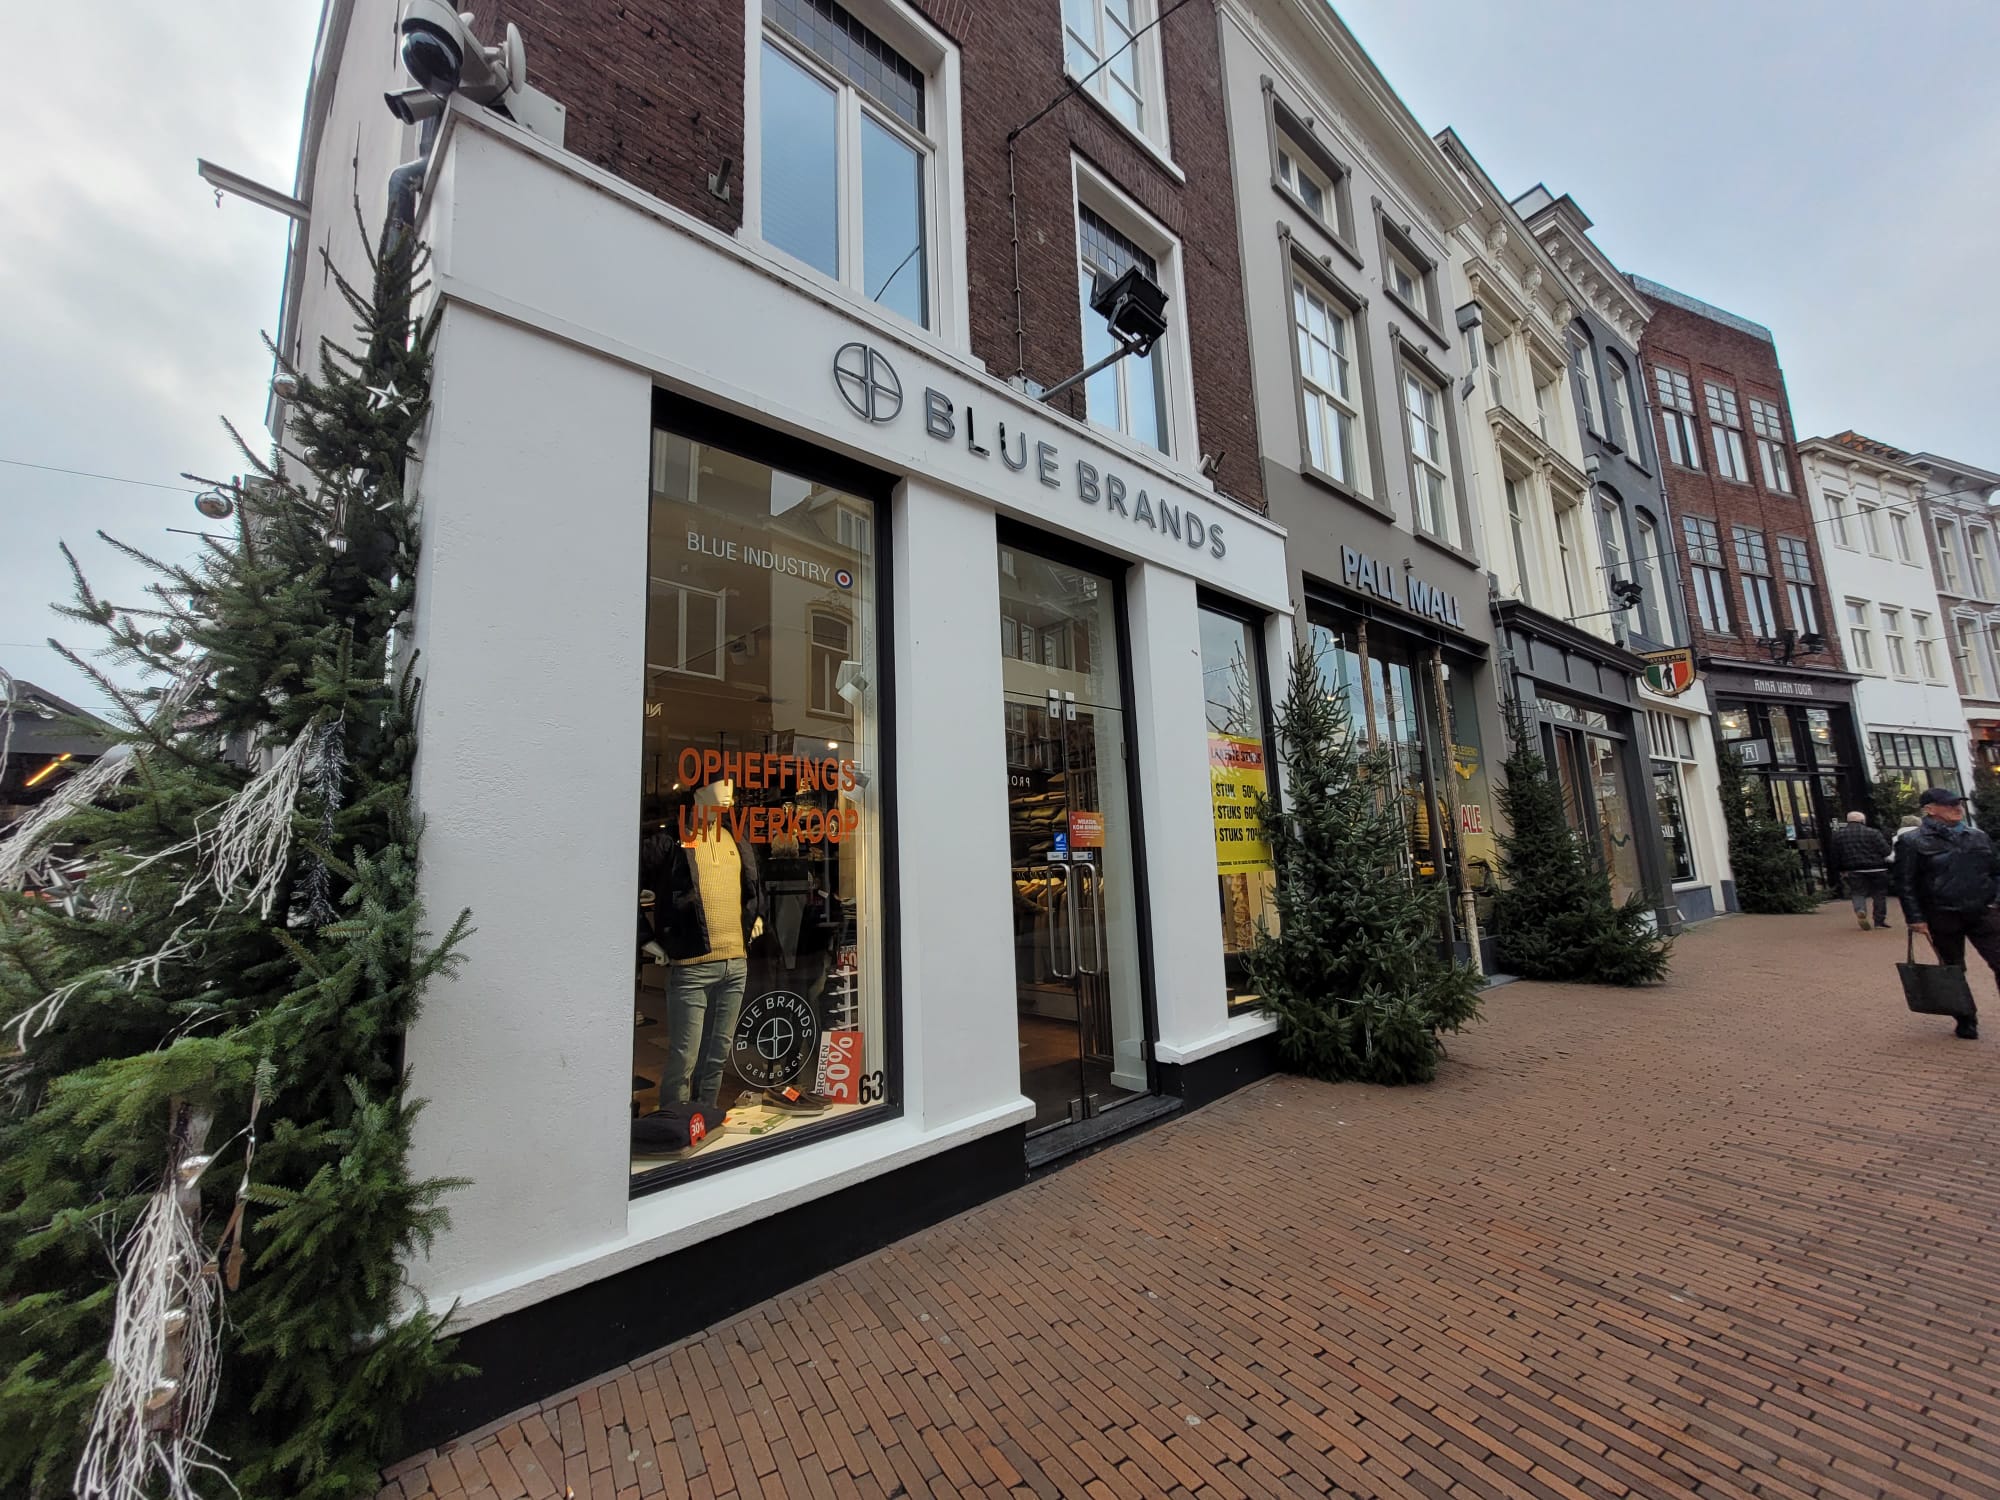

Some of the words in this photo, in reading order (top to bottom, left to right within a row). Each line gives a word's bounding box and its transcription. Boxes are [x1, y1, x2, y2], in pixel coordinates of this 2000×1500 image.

[925, 386, 1061, 487] BLUE
[1077, 459, 1227, 559] BRANDS
[687, 531, 737, 561] BLUE
[743, 545, 831, 583] INDUSTRY
[1340, 544, 1403, 606] PALL
[1406, 574, 1465, 632] MALL
[1754, 679, 1776, 693] ANNA
[1776, 681, 1793, 694] VAN
[1793, 683, 1814, 696] TOOR
[678, 747, 857, 792] OPHEFFINGS
[678, 804, 859, 844] UITVERKOOP
[1217, 805, 1242, 820] STUKS
[1219, 827, 1244, 842] STUKS
[1460, 804, 1483, 835] ALE
[736, 1008, 763, 1051] BLUE
[765, 995, 812, 1038] BRANDS
[815, 1044, 830, 1095] BROEKEN
[824, 1036, 853, 1099] 50%
[858, 1070, 884, 1105] 63
